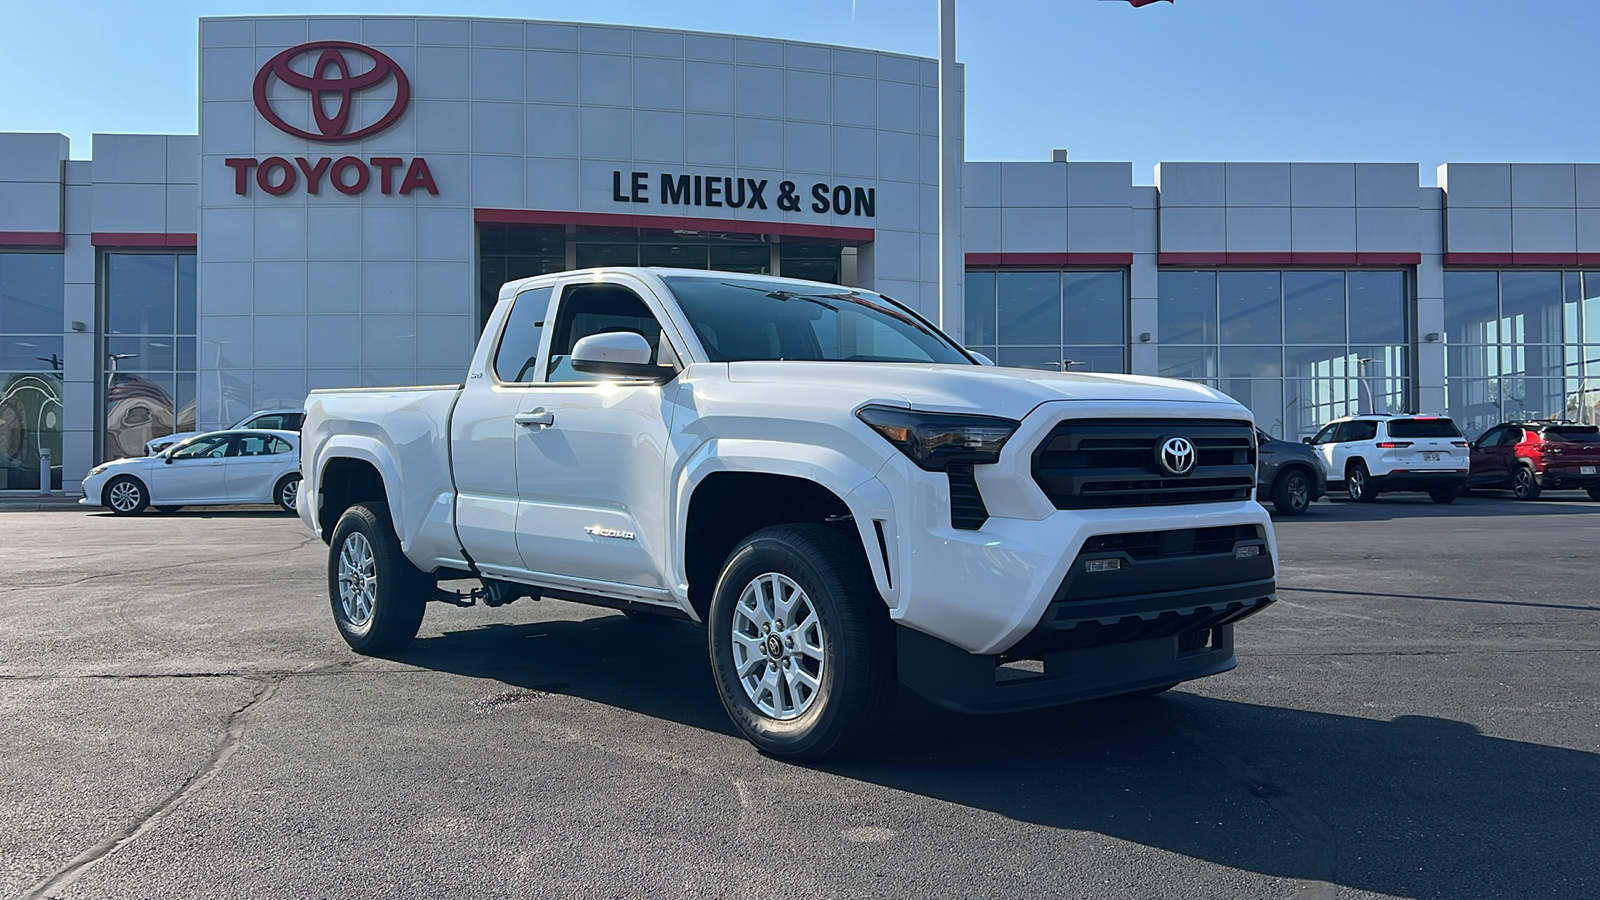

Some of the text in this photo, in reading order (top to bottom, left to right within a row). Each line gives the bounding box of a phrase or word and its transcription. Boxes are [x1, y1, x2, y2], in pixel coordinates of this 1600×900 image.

[225, 156, 439, 195] TOYOTA
[613, 171, 876, 217] LE MIEUX & SON
